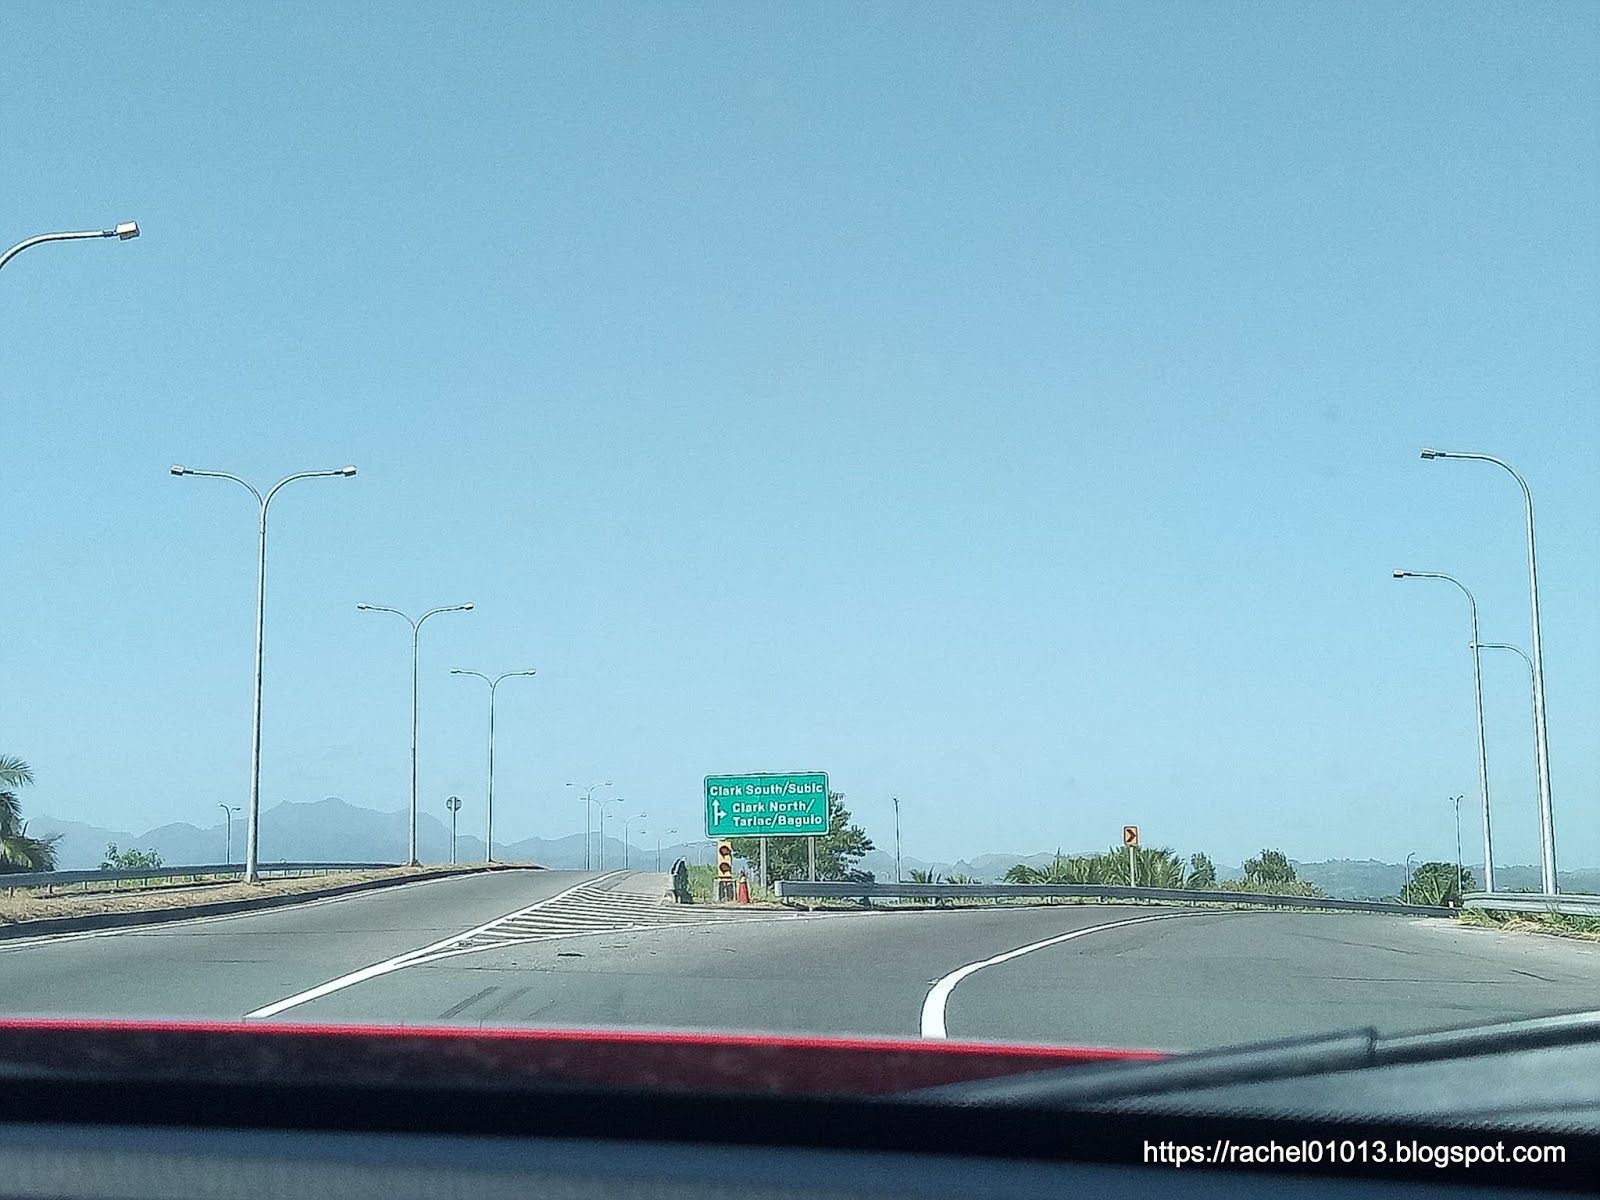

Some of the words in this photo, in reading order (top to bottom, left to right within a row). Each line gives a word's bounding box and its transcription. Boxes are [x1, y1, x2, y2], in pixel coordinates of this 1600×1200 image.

[709, 785, 742, 796] Clark
[745, 781, 823, 797] South/Subic
[732, 802, 765, 813] Clark
[769, 798, 815, 813] North/
[732, 813, 823, 829] Tarlac/Baguio
